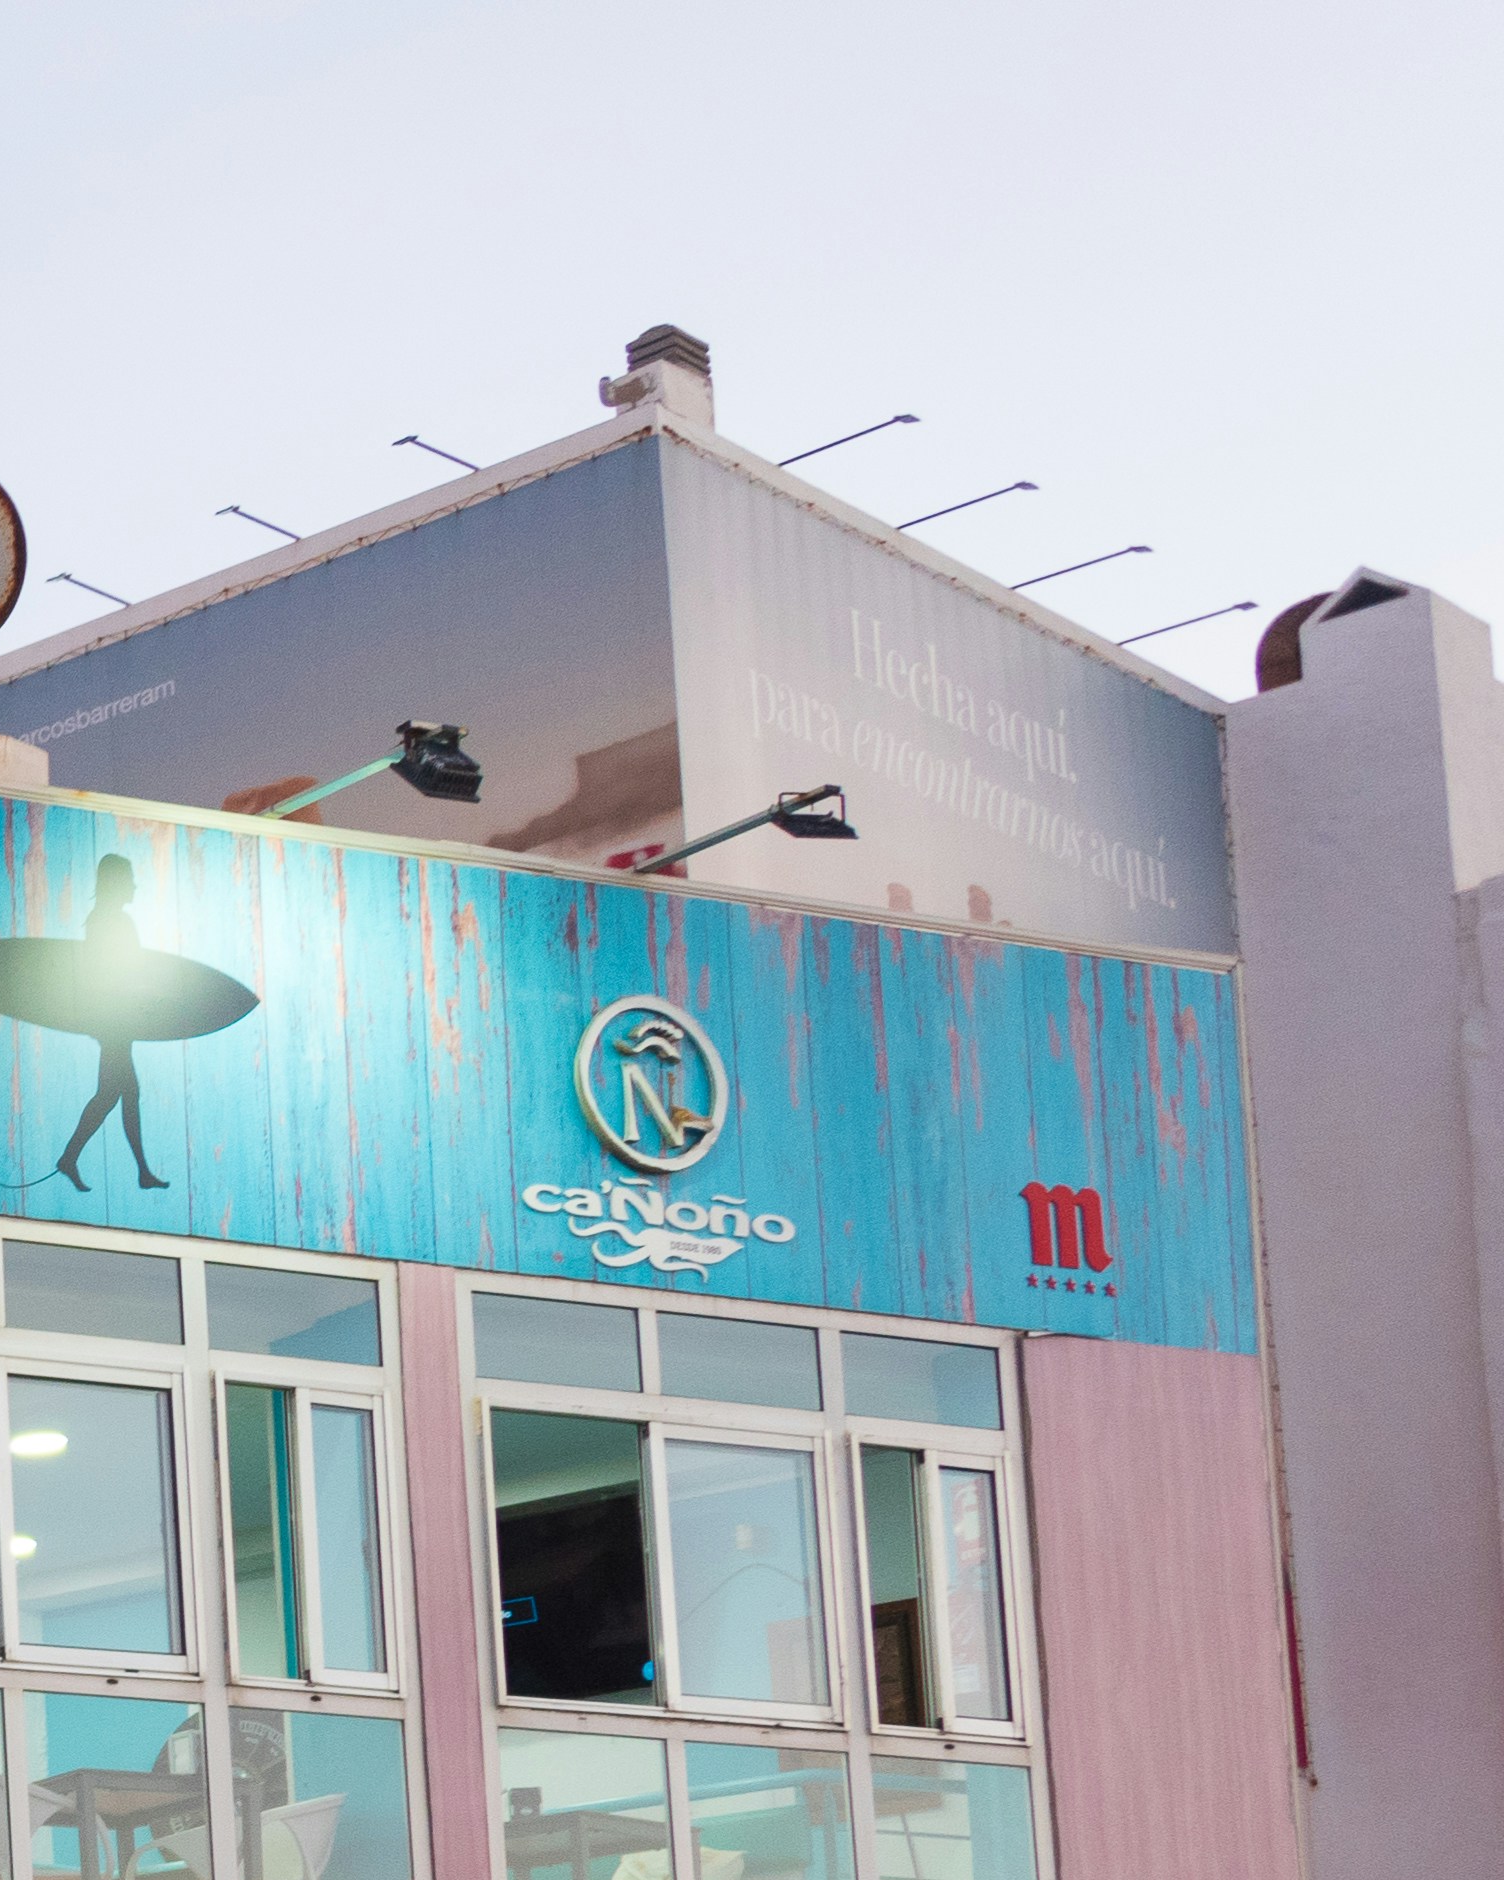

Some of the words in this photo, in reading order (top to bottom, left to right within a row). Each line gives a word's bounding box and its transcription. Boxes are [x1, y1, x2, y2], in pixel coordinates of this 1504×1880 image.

[18, 679, 176, 746] arcosbarreram
[850, 608, 977, 738] Hecha
[987, 707, 1078, 784] aquí.
[750, 668, 842, 758] para
[852, 719, 1083, 868] encontrarnos
[1090, 836, 1178, 911] aquí.
[1020, 1181, 1114, 1273] m
